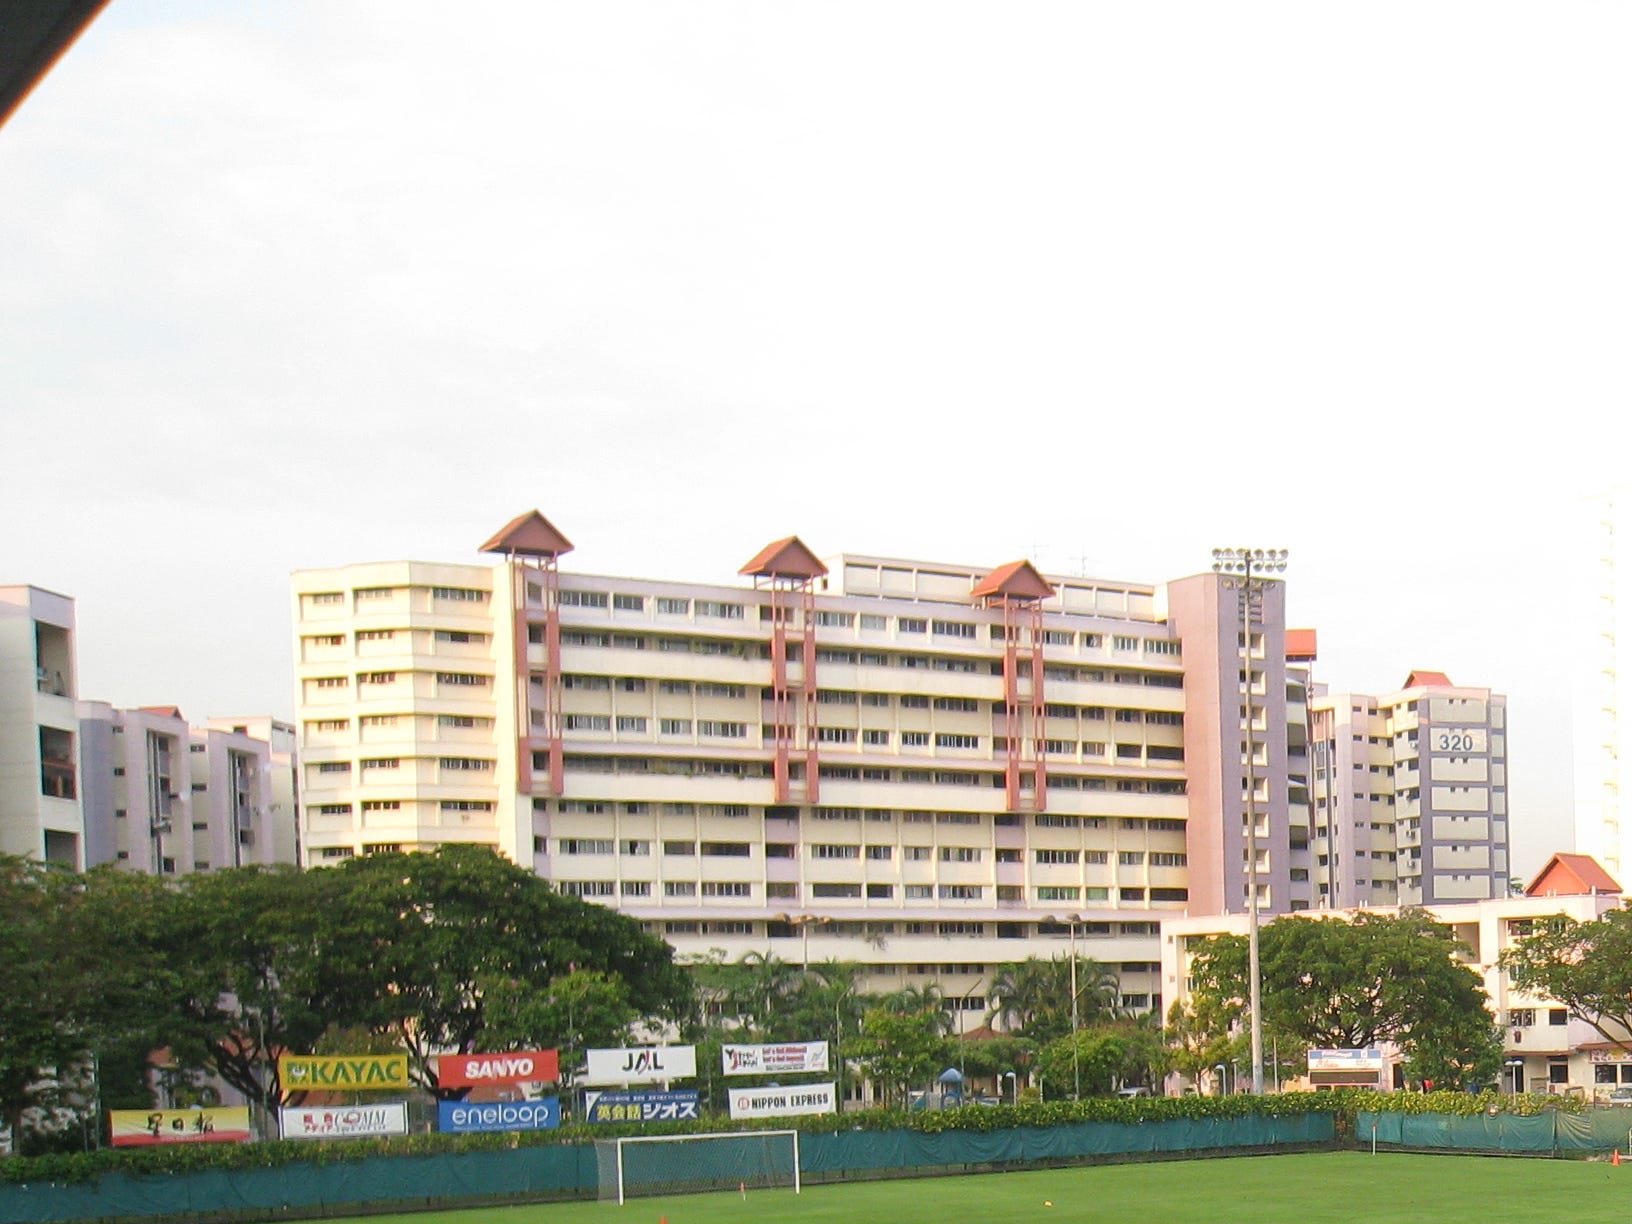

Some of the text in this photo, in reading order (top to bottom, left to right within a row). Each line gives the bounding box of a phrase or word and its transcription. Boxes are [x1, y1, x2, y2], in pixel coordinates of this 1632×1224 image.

[1440, 734, 1473, 751] 320
[310, 1060, 401, 1083] KAYAC
[464, 1057, 534, 1080] SANYO
[621, 1049, 665, 1075] JAL
[751, 1093, 829, 1110] NIPPON EXPRESS
[452, 1104, 548, 1128] eneloop
